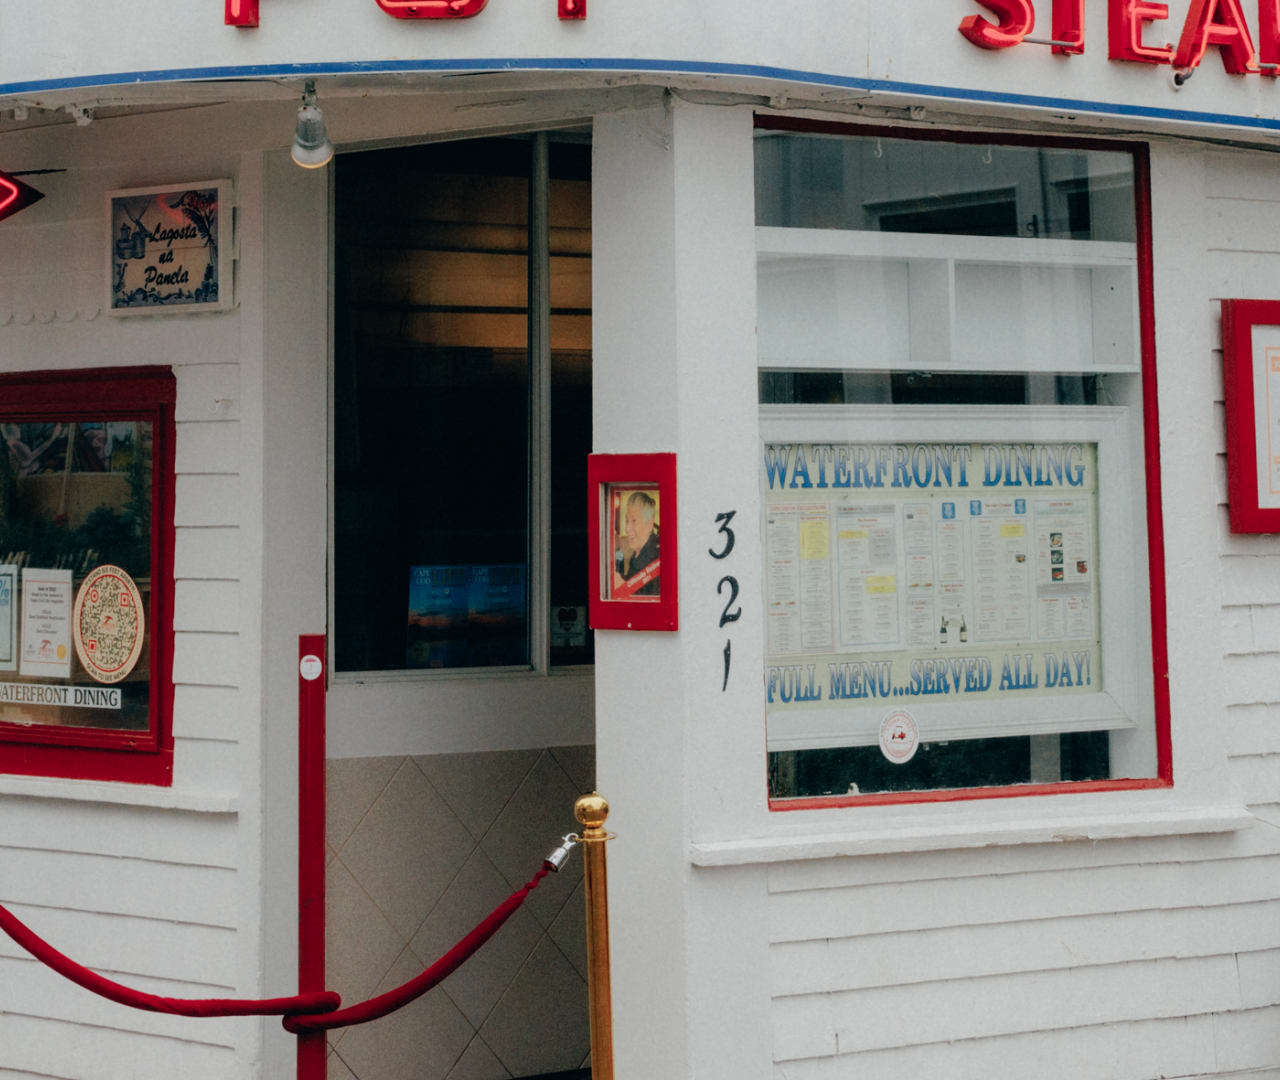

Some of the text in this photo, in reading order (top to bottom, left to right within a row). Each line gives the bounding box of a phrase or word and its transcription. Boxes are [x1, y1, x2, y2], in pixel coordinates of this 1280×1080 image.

[149, 222, 197, 248] Lagosta
[159, 249, 174, 264] na
[144, 265, 189, 289] Panela
[764, 443, 1086, 490] WATERFRONT DINING
[767, 664, 821, 703] FULL
[999, 653, 1038, 690] ALL
[1044, 650, 1092, 688] DAY!
[74, 688, 118, 707] DINING
